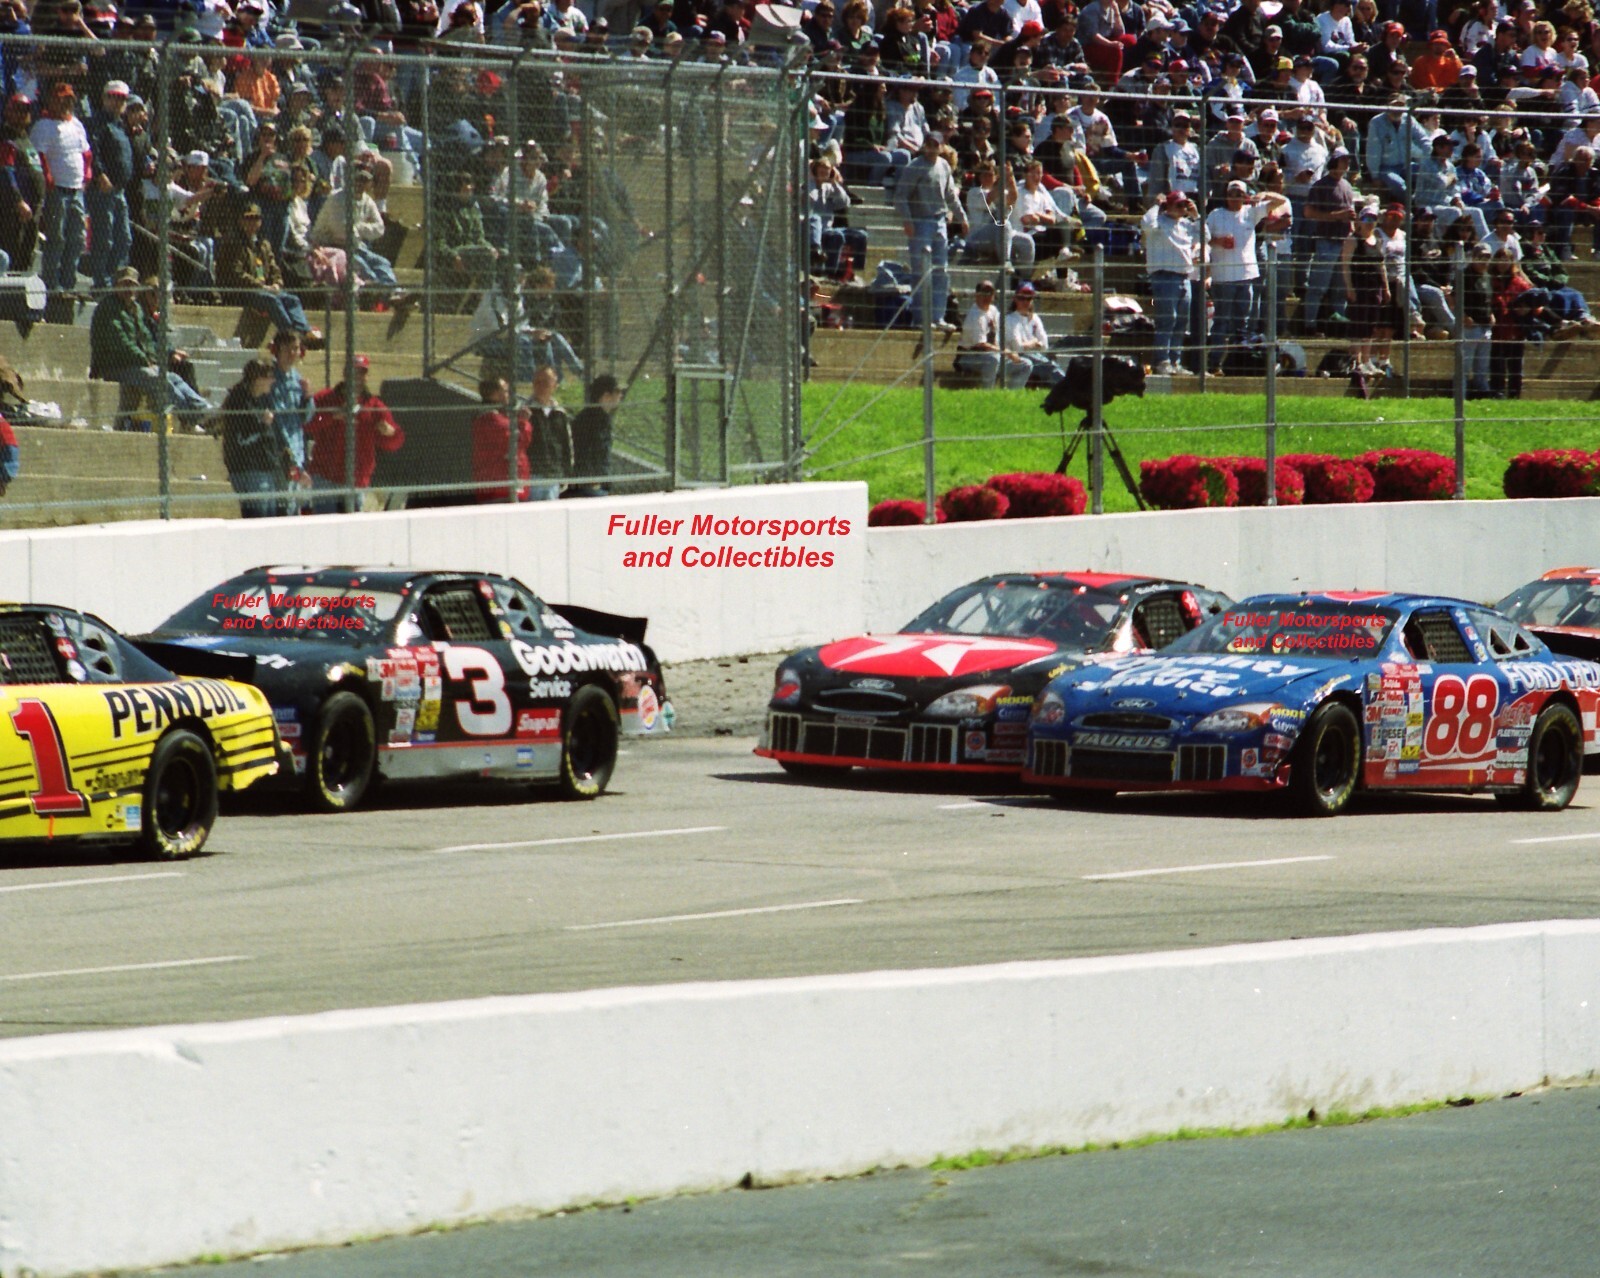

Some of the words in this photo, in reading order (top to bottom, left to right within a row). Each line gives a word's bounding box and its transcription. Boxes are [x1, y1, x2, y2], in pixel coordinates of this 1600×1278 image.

[103, 679, 248, 741] PENNZOIL
[443, 644, 513, 737] 3
[529, 674, 572, 700] Service
[1366, 706, 1382, 723] 3M
[1423, 673, 1499, 760] 88
[10, 697, 91, 818] 1
[1073, 732, 1170, 750] TAURUS
